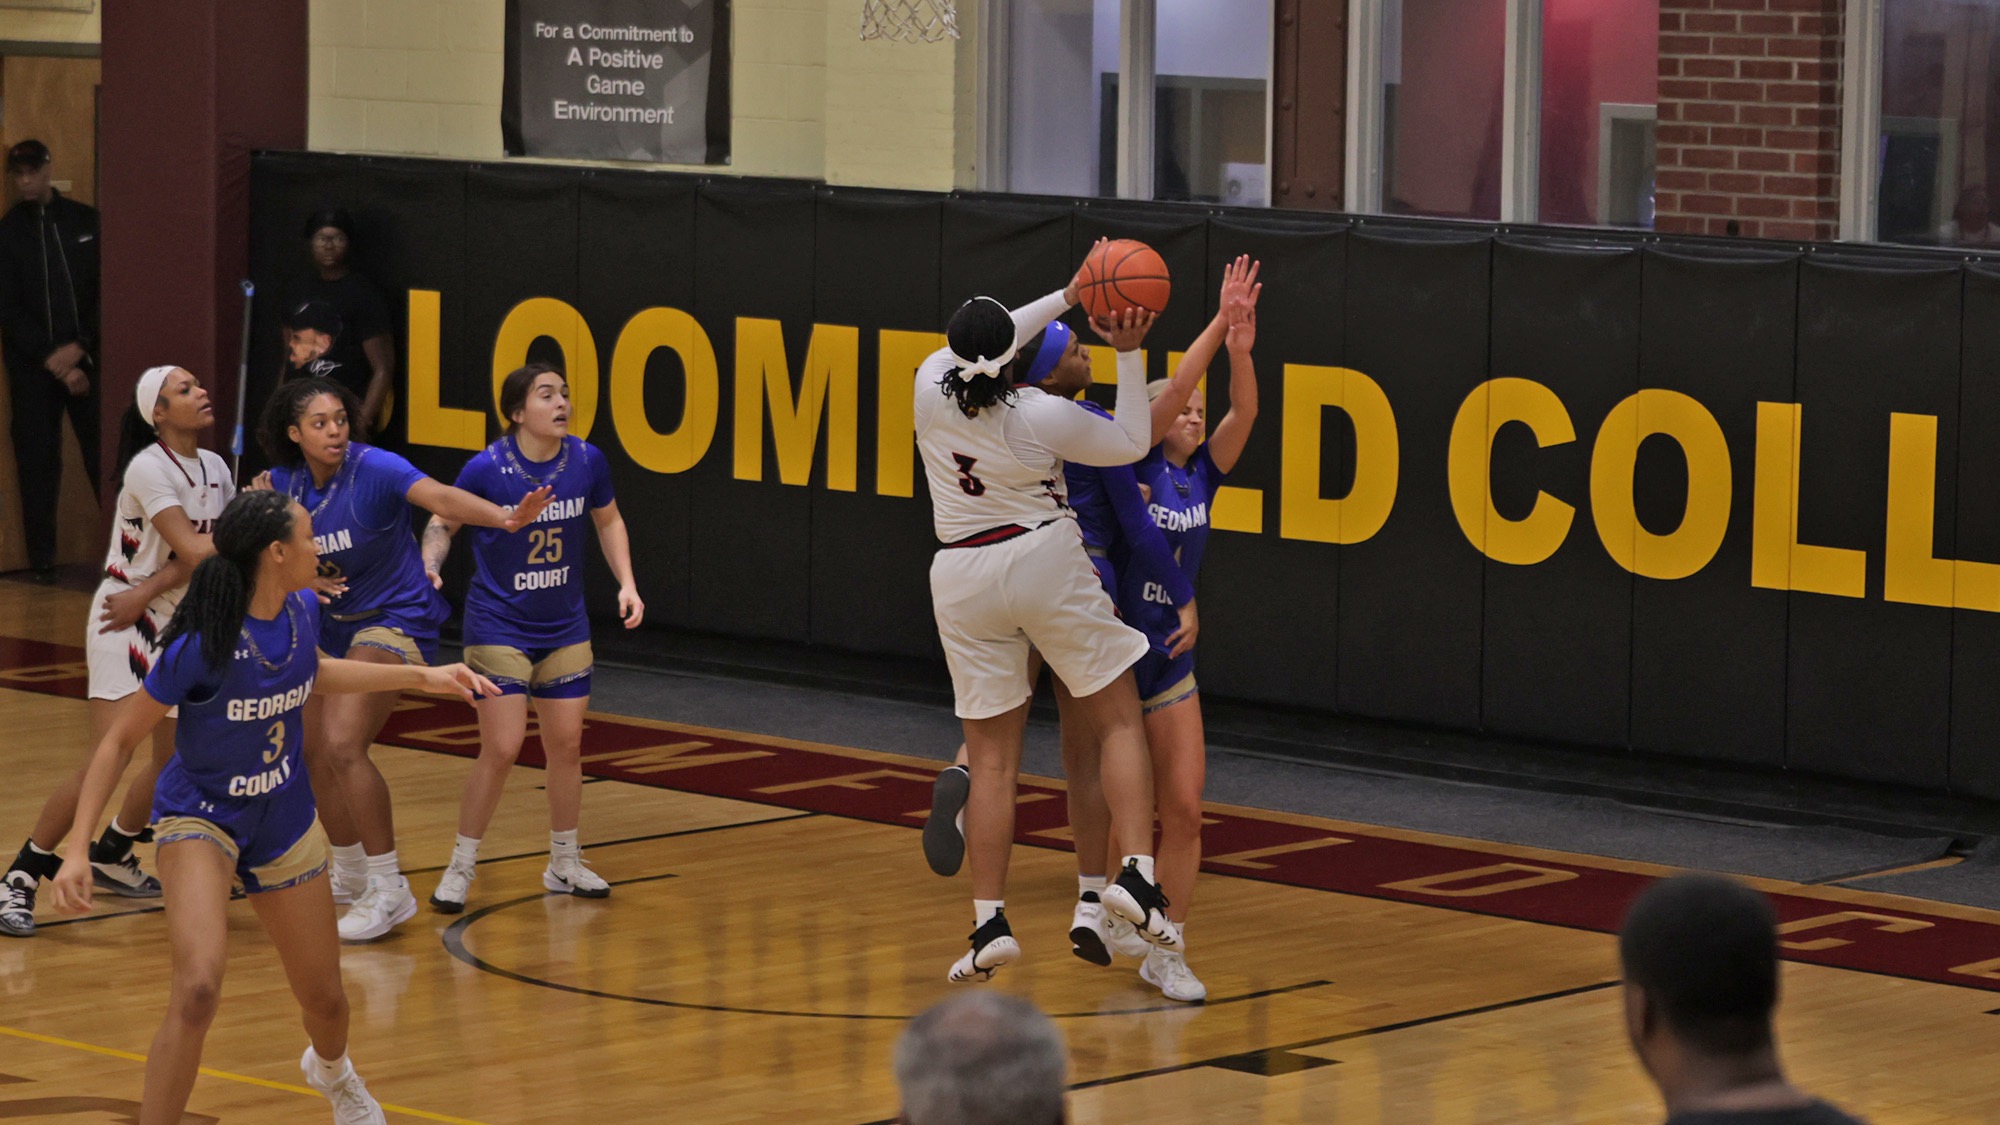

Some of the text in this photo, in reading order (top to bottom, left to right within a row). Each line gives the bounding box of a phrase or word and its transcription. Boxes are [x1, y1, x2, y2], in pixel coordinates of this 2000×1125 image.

[536, 22, 694, 43] For a Commitment to
[567, 47, 663, 69] A Positive
[587, 75, 645, 96] Game
[554, 100, 674, 124] Environment
[952, 451, 986, 497] 3
[527, 527, 563, 564] 25
[514, 565, 570, 591] COURT
[263, 721, 285, 764] 3
